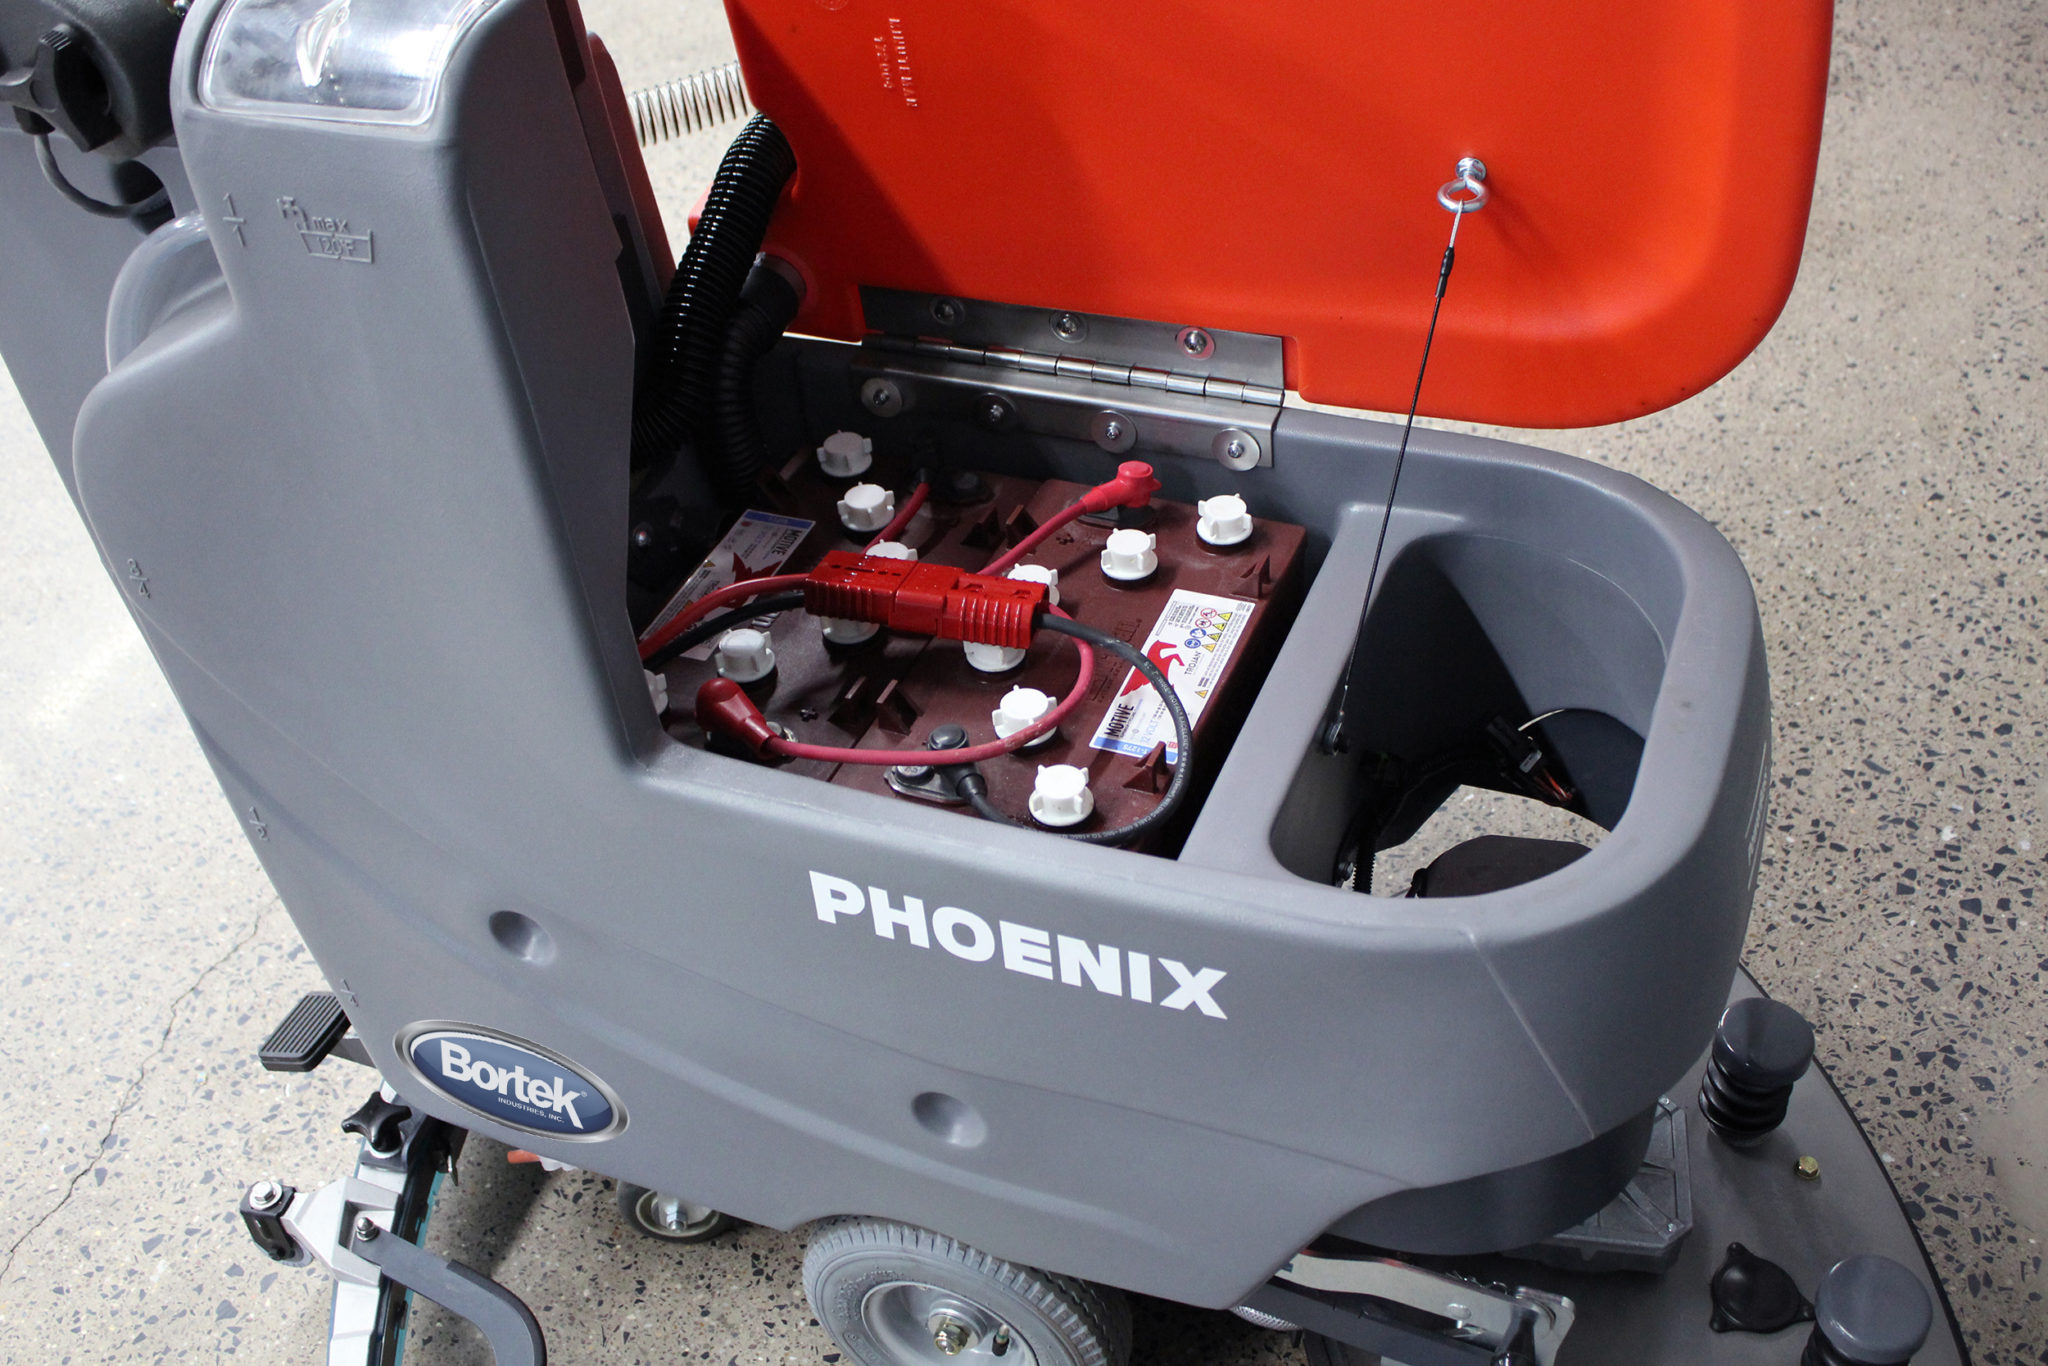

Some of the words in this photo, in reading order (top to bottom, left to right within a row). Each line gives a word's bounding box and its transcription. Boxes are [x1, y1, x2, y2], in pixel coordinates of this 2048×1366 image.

[311, 216, 350, 233] max
[1184, 651, 1201, 675] TROJAN
[1104, 703, 1134, 738] MOTIVE
[1149, 795, 1172, 818] WELDING
[809, 870, 1228, 1020] PHOENIX
[440, 1039, 584, 1130] Bortek
[498, 1097, 547, 1118] INDUSTRIES,
[548, 1113, 565, 1124] INC.
